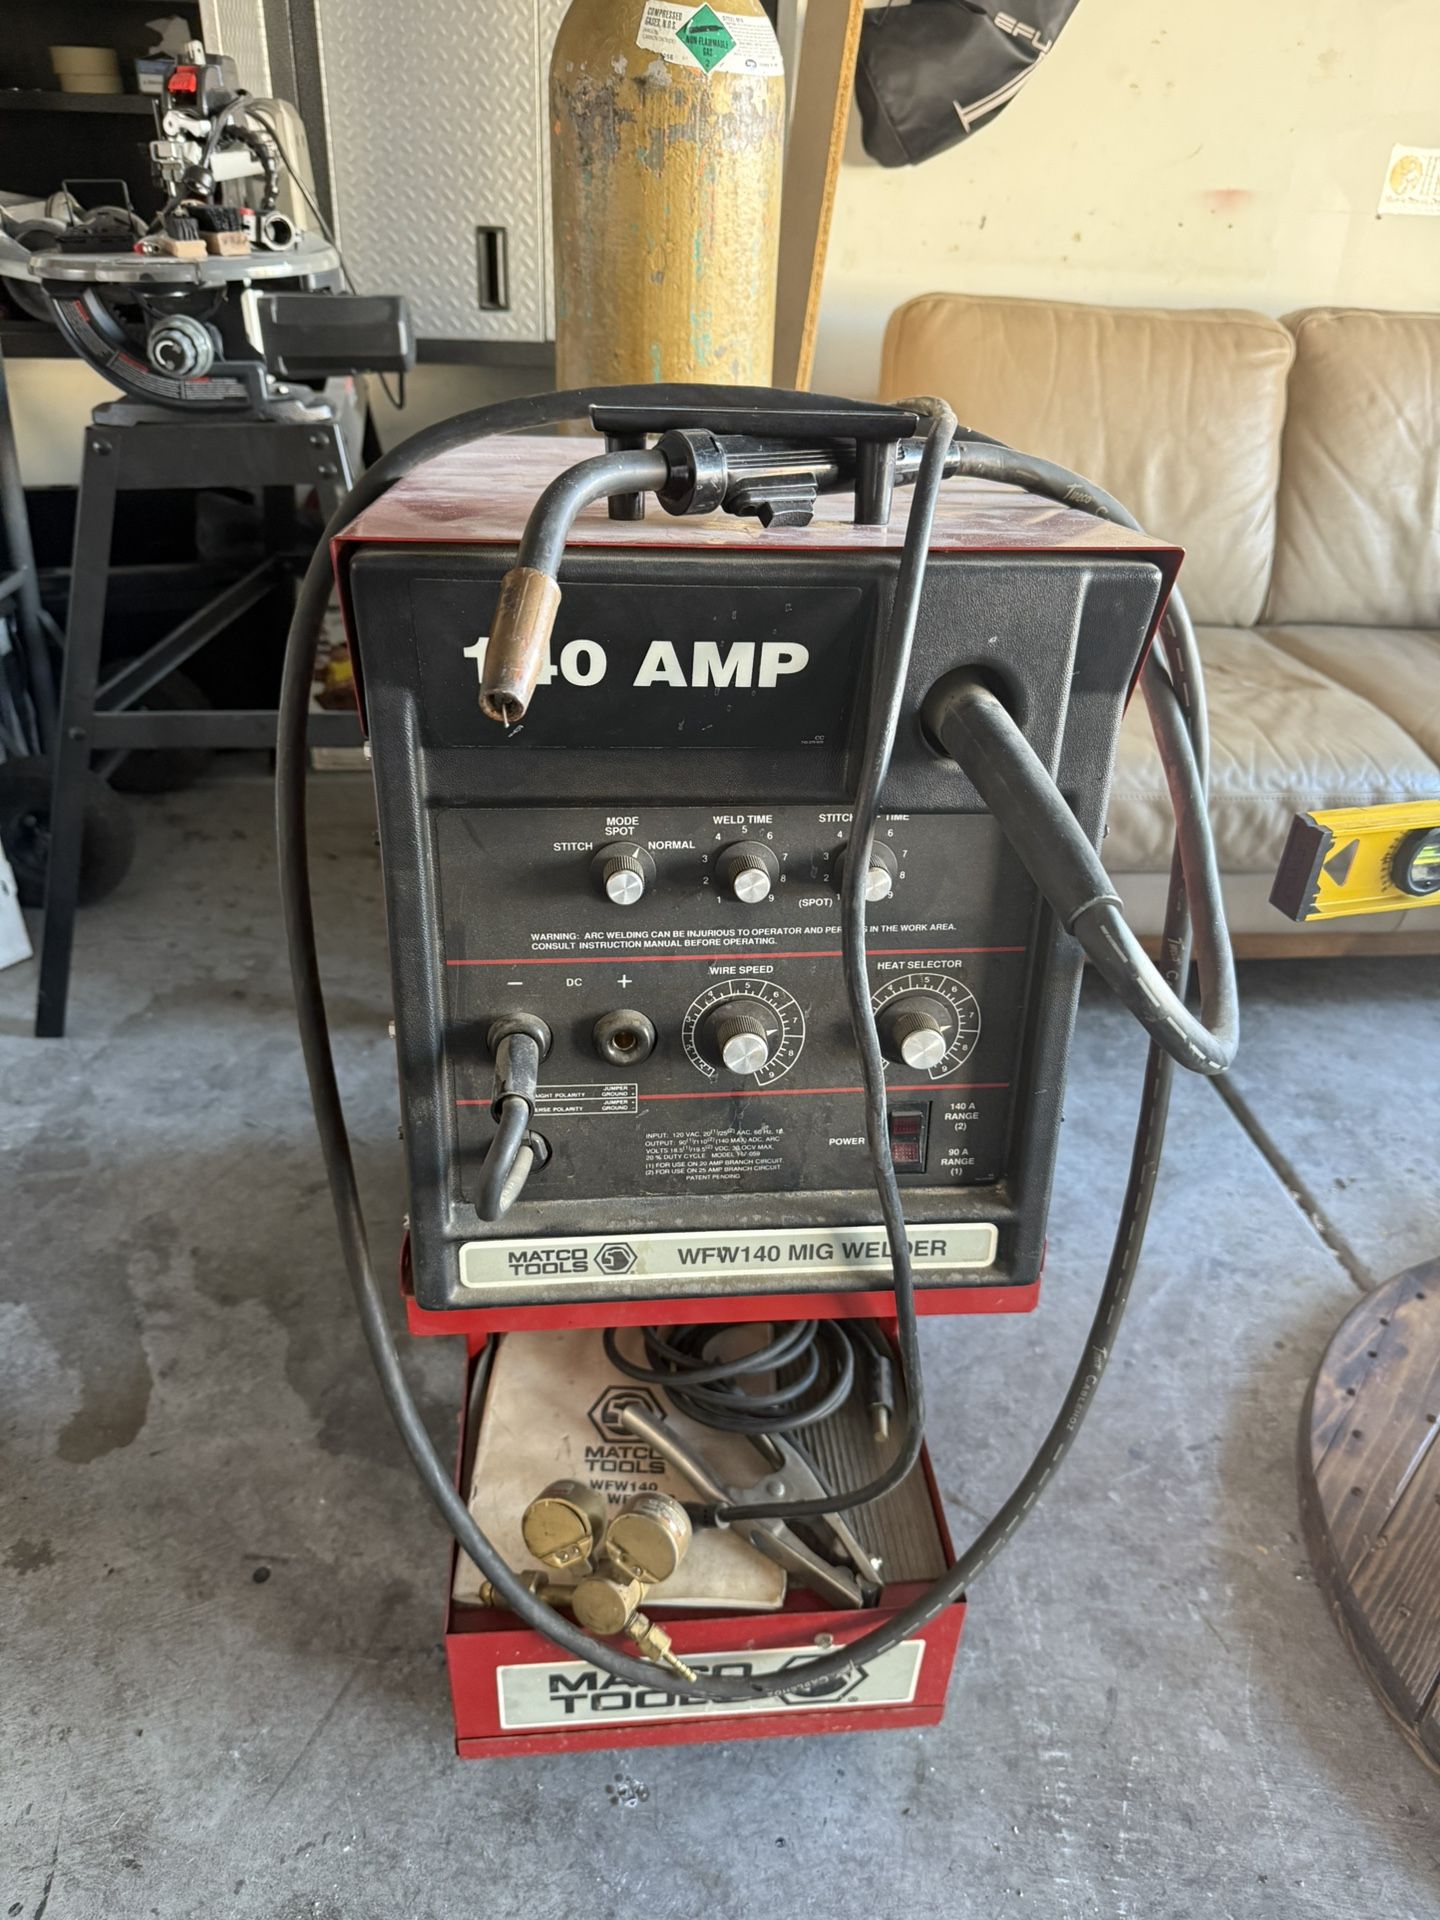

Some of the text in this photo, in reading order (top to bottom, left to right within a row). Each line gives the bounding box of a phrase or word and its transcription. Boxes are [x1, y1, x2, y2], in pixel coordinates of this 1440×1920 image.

[648, 7, 682, 20] COMPRESSED
[632, 640, 810, 688] AMP
[606, 817, 639, 826] MODE
[713, 815, 772, 824] WELD TIME
[605, 827, 635, 836] SPOT
[742, 826, 748, 834] 5
[887, 829, 894, 838] 6
[715, 833, 721, 841] 4
[767, 832, 773, 840] 6
[554, 842, 593, 851] STITCH
[648, 841, 695, 850] NORMAL
[902, 850, 908, 858] 7
[702, 855, 708, 863] 3
[780, 874, 786, 882] 8
[823, 874, 829, 882] 2
[900, 871, 906, 879] 8
[716, 896, 721, 904] 1
[768, 894, 774, 902] 9
[798, 898, 832, 908] (SPOT)
[531, 932, 580, 940] WARNING:
[584, 932, 604, 940] ARC
[606, 931, 648, 939] WELDING
[651, 930, 670, 938] CAN
[672, 930, 685, 938] BE
[687, 929, 735, 938] INJURIOUS
[738, 928, 750, 936] TO
[752, 927, 802, 936] OPERATOR
[804, 926, 824, 934] AND
[825, 925, 868, 934] PERS
[900, 924, 928, 932] WORK
[930, 923, 956, 931] AREA.
[532, 937, 778, 950] CONSULT INSTRUCTION MANUAL BEFORE OPERATING.
[709, 965, 774, 974] WIRE SPEED
[878, 960, 962, 970] HEAT SELECTOR
[566, 978, 583, 987] DC
[944, 1112, 980, 1120] RANGE
[954, 1122, 967, 1131] (2)
[828, 1138, 866, 1146] POWER
[962, 1148, 969, 1156] A
[940, 1157, 975, 1166] RANGE
[950, 1168, 962, 1176] (1)
[508, 1248, 588, 1264] MATCO
[678, 1245, 780, 1264] WFW140
[788, 1243, 834, 1261] MIG
[509, 1261, 588, 1276] TOOLS
[585, 1460, 666, 1474] TOOLS
[590, 1480, 658, 1492] WFW140
[550, 1690, 740, 1714] TOOL
